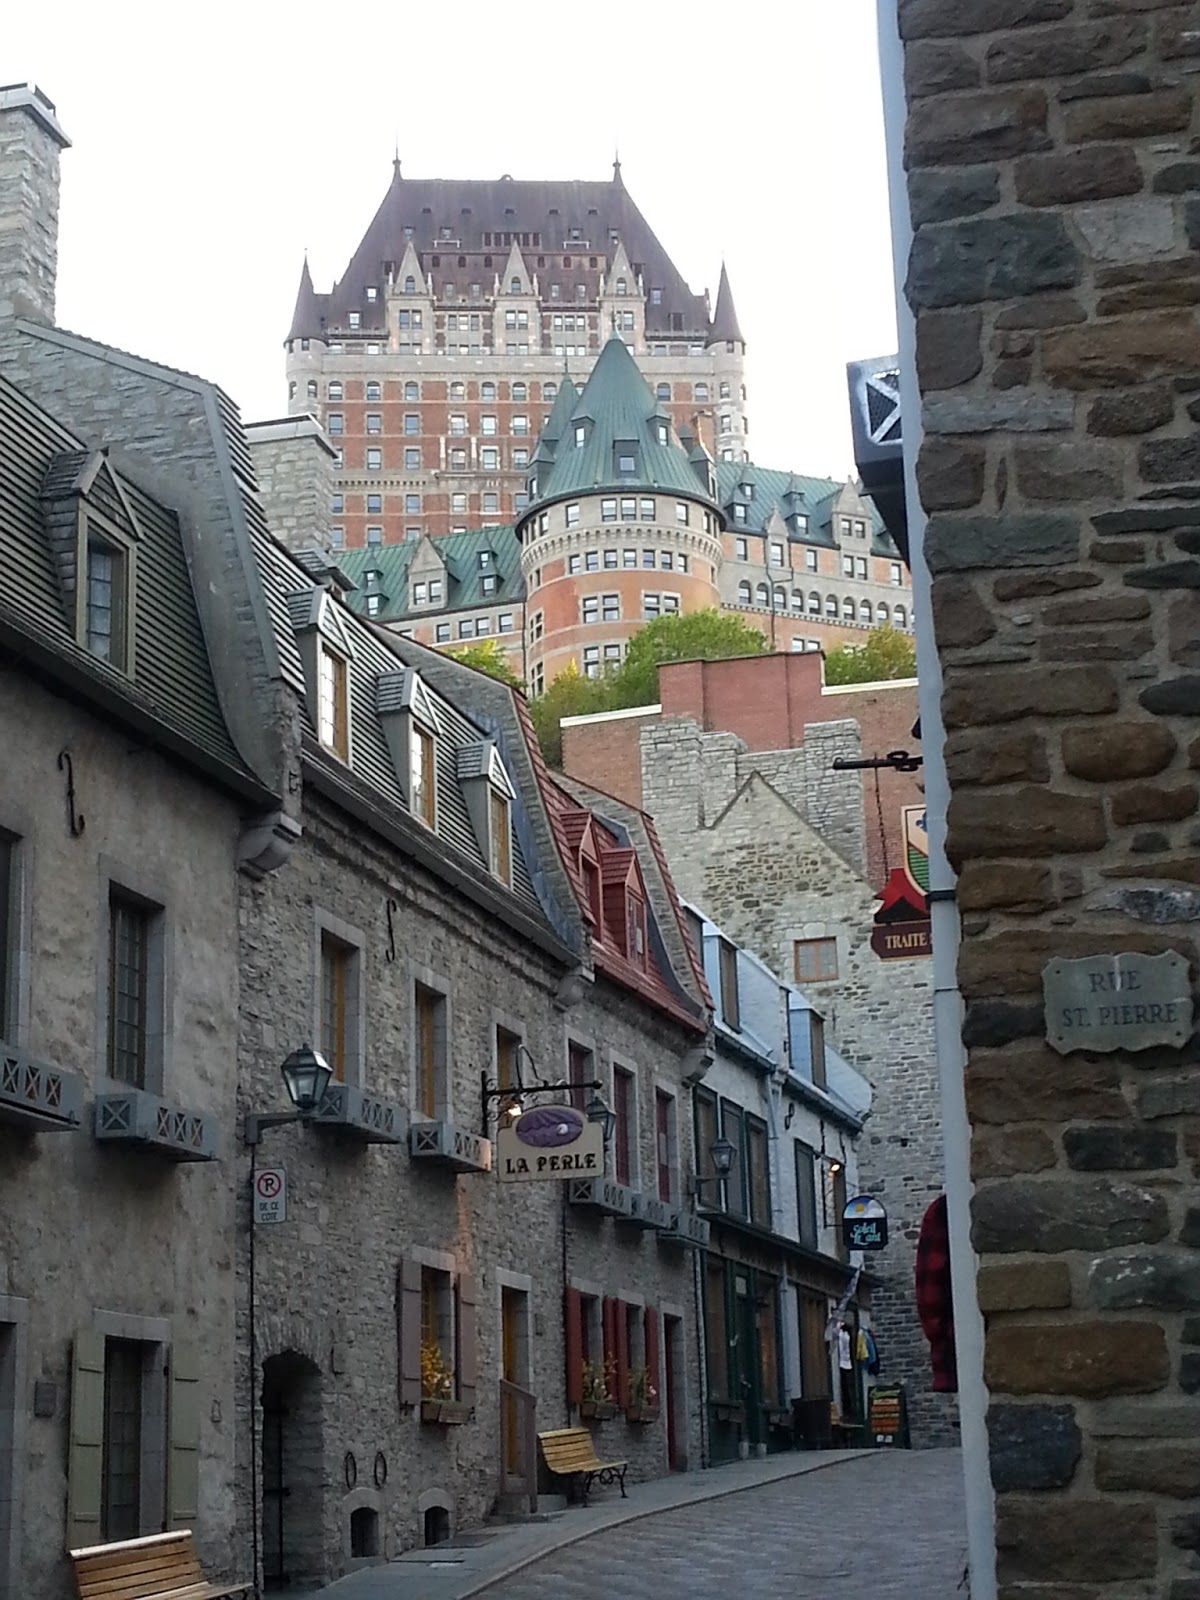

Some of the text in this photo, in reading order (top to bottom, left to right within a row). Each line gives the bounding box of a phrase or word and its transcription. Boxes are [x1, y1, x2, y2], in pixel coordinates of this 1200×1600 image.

[884, 932, 928, 949] TRAITE
[1088, 970, 1141, 993] RUE
[1062, 1003, 1177, 1028] ST. PIERRE
[506, 1153, 597, 1174] LA PERLE
[259, 1201, 279, 1211] DE CE
